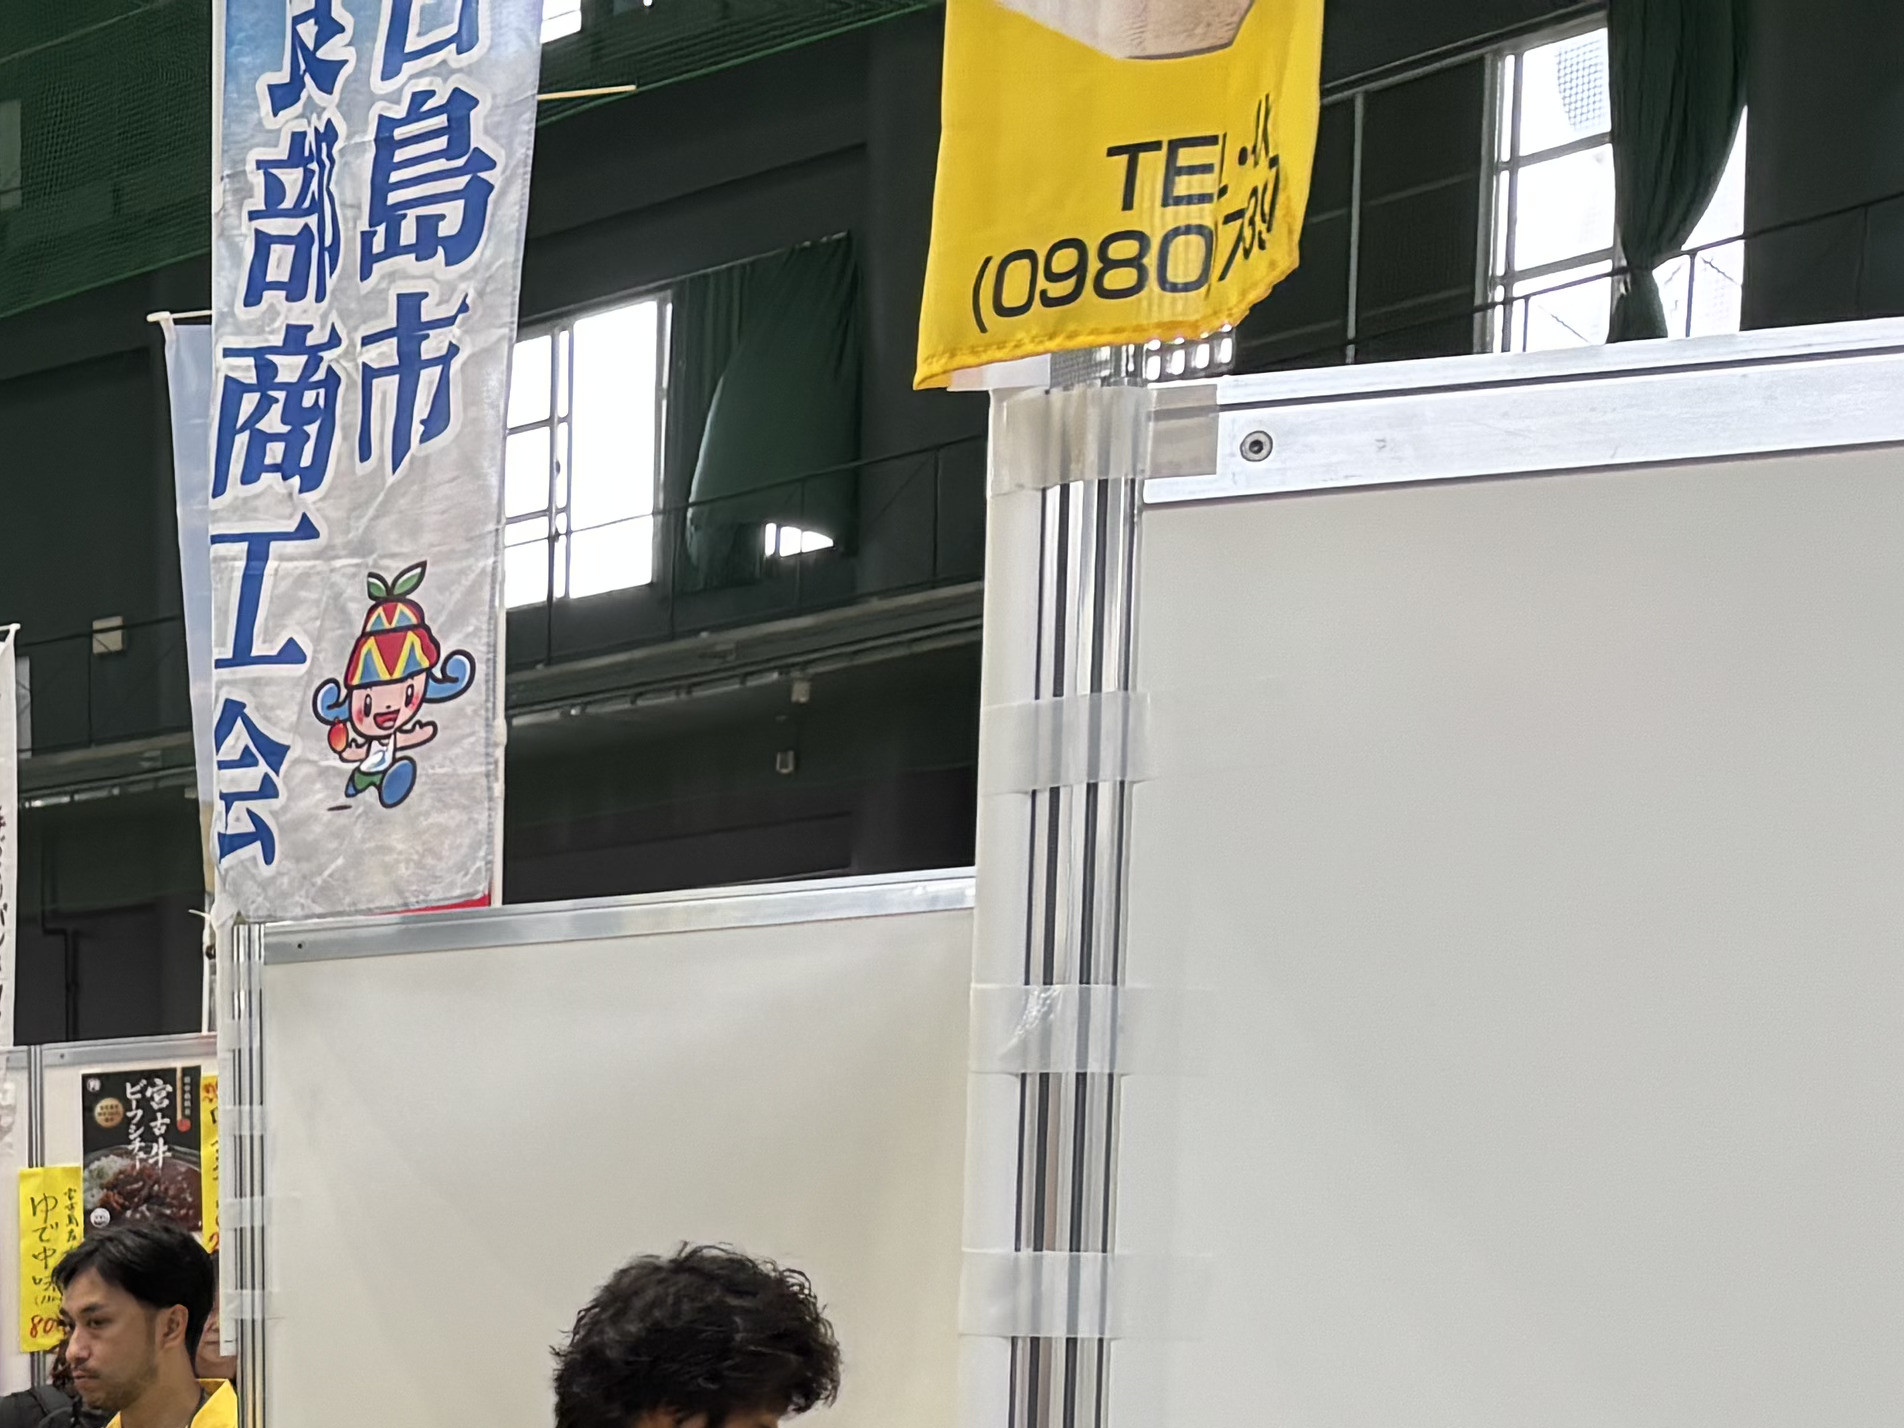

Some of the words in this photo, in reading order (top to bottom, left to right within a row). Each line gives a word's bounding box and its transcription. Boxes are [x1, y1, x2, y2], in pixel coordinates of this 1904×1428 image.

[145, 1077, 173, 1170] 宮古牛
[29, 1313, 65, 1338] 80
